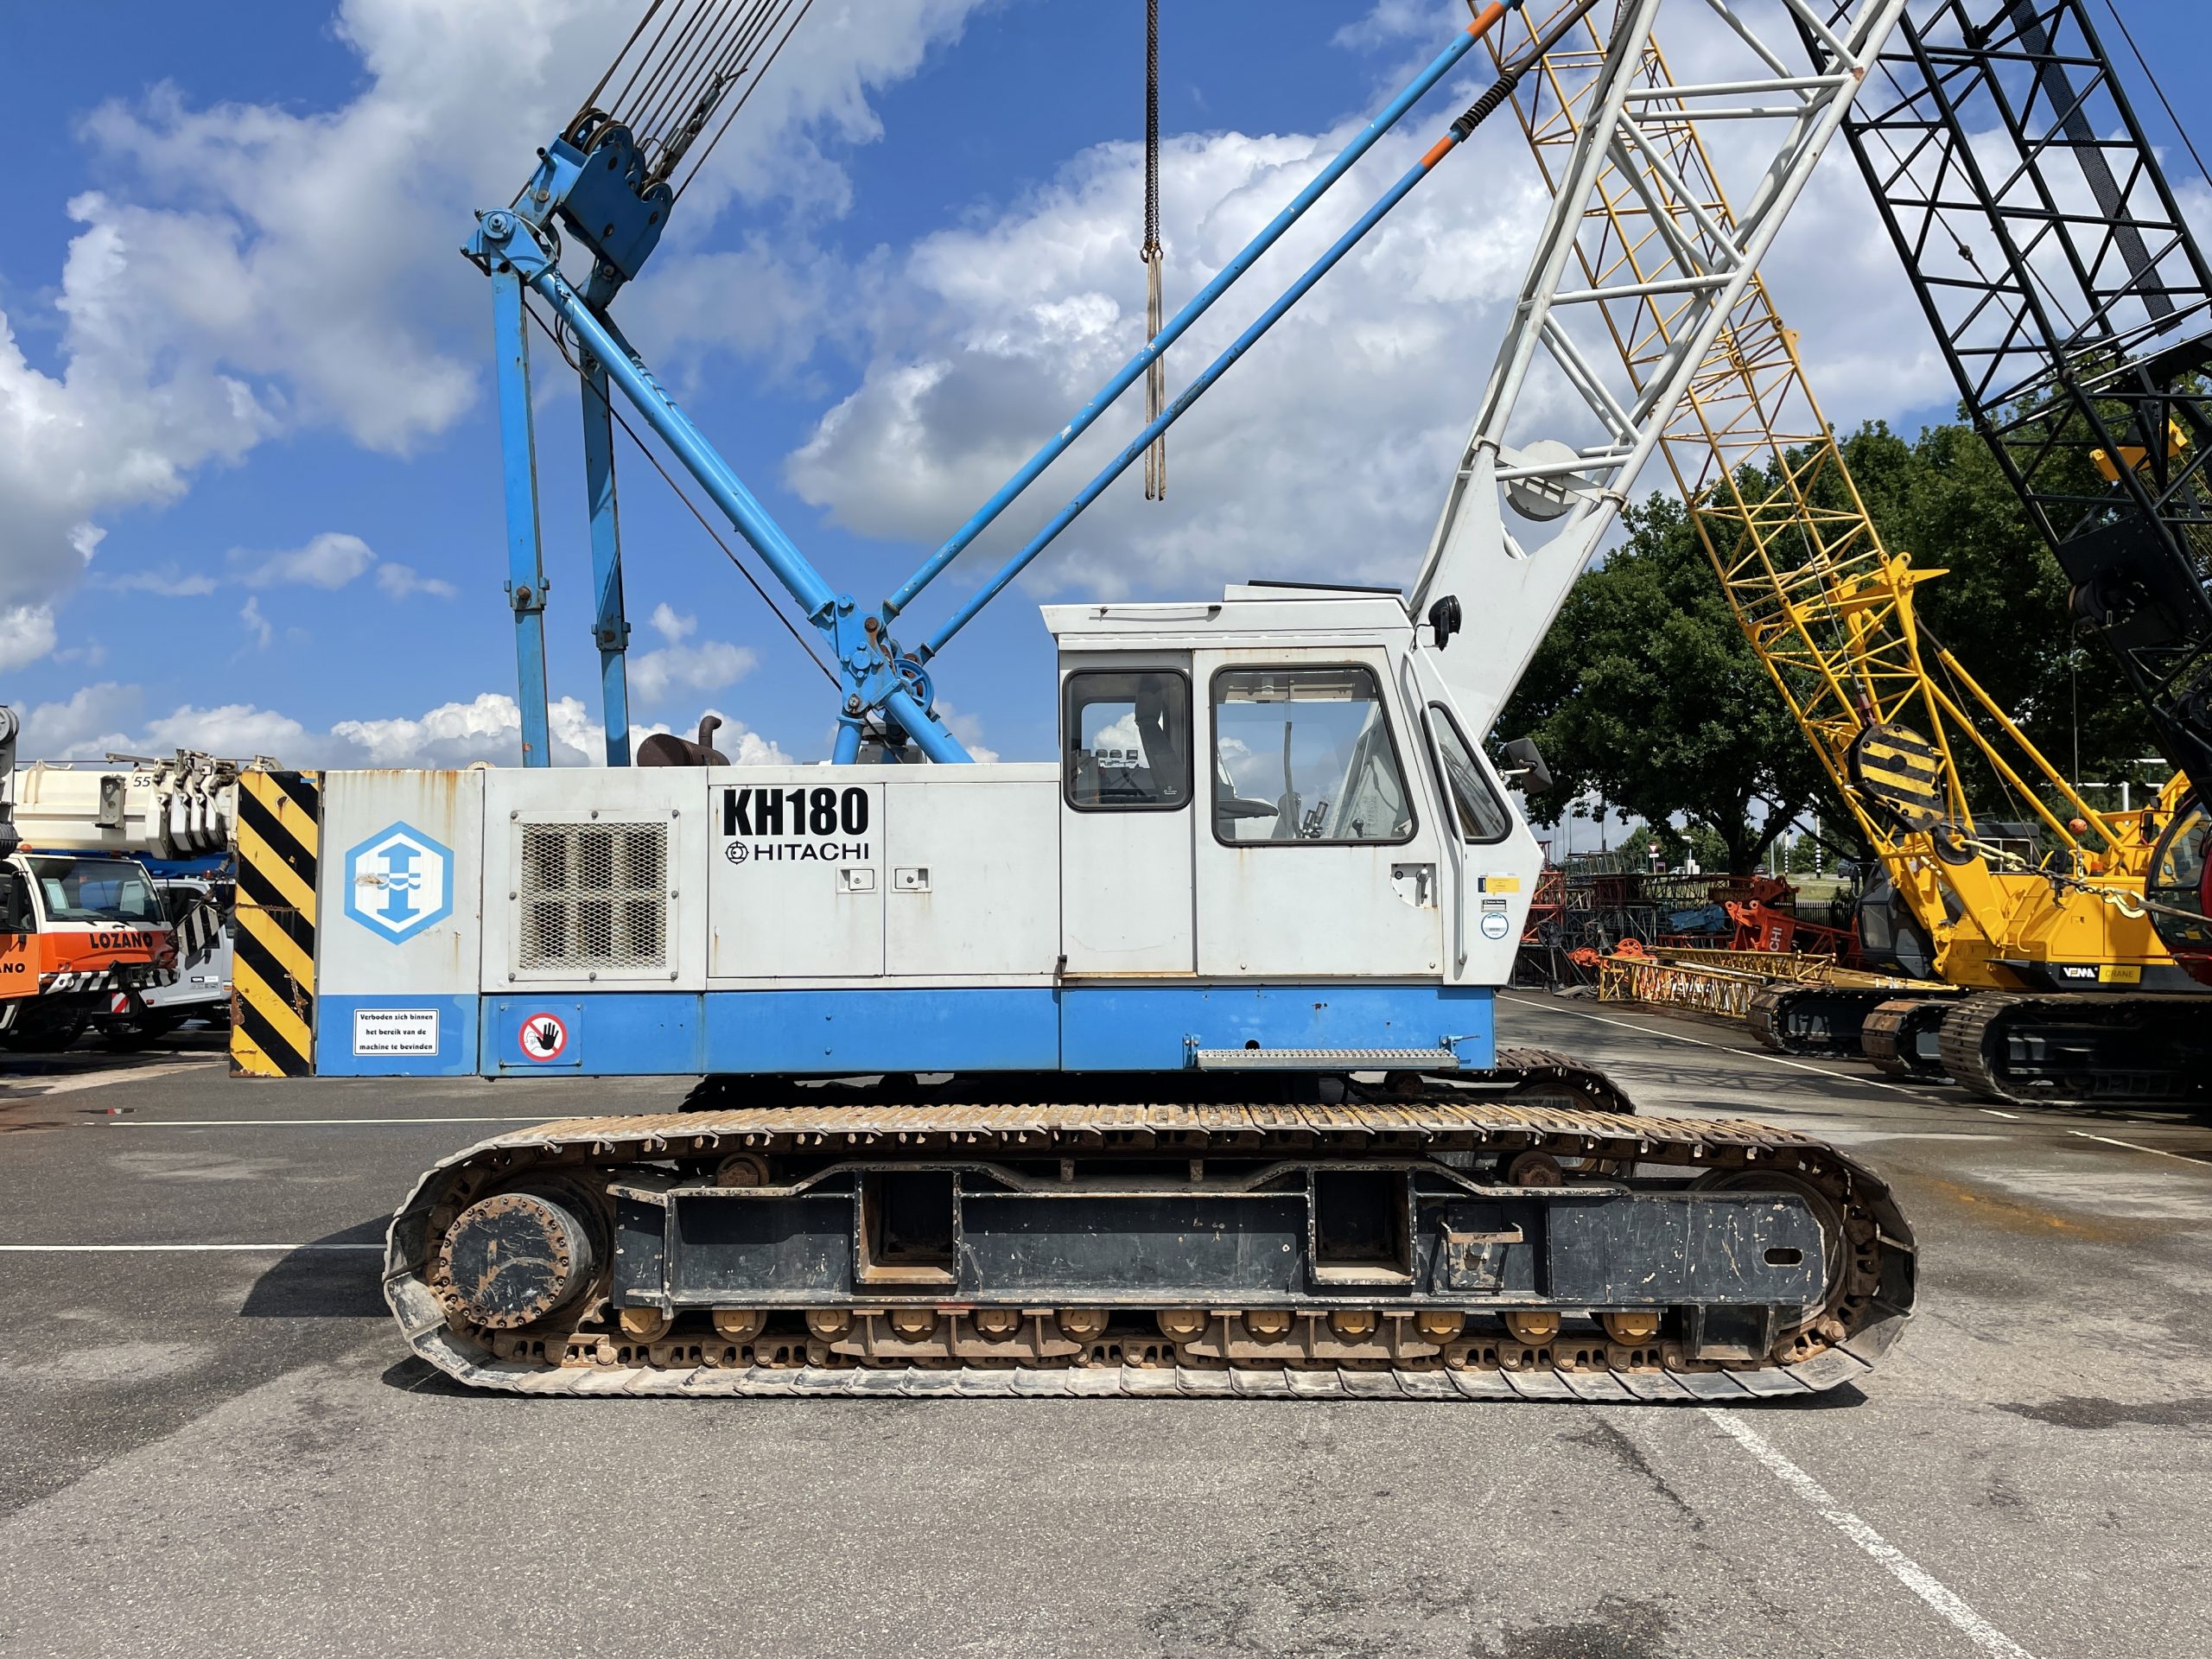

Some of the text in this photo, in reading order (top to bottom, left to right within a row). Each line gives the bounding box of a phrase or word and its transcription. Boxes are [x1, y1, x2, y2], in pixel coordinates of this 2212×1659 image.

[133, 776, 151, 787] 55
[723, 787, 868, 836] KH180
[754, 842, 869, 861] HITACHI
[89, 932, 153, 949] LOZANO
[2105, 969, 2134, 978] CRANE
